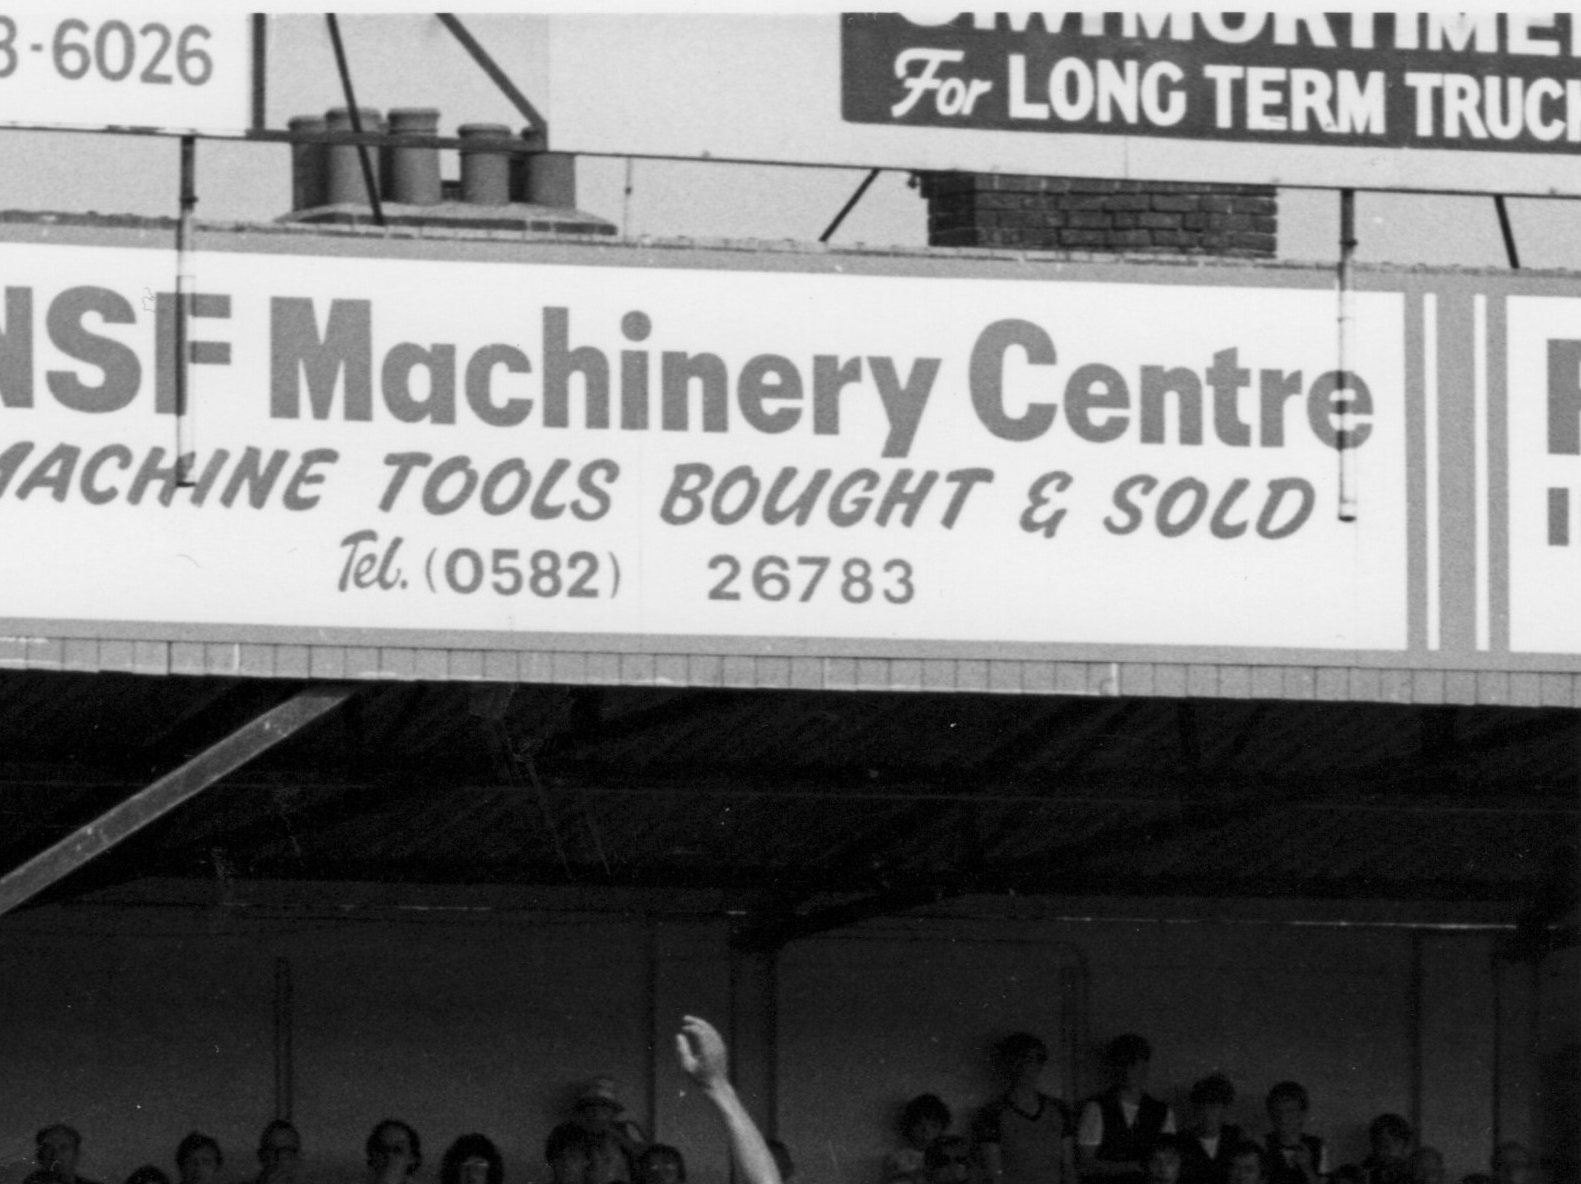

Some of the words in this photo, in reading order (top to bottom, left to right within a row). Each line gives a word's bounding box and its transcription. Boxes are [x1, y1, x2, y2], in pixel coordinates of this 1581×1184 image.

[892, 48, 992, 117] For
[1009, 54, 1186, 126] LONG
[1204, 65, 1385, 134] TERM
[267, 297, 941, 459] Machinery
[969, 319, 1374, 452] Centre
[379, 452, 620, 521] TOOLS
[660, 463, 994, 529] BOUGHT
[1020, 471, 1074, 539] &
[1104, 474, 1316, 540] SOLD
[338, 530, 408, 593] Tel.
[425, 547, 621, 599] (0582)
[707, 554, 915, 605] 26783
